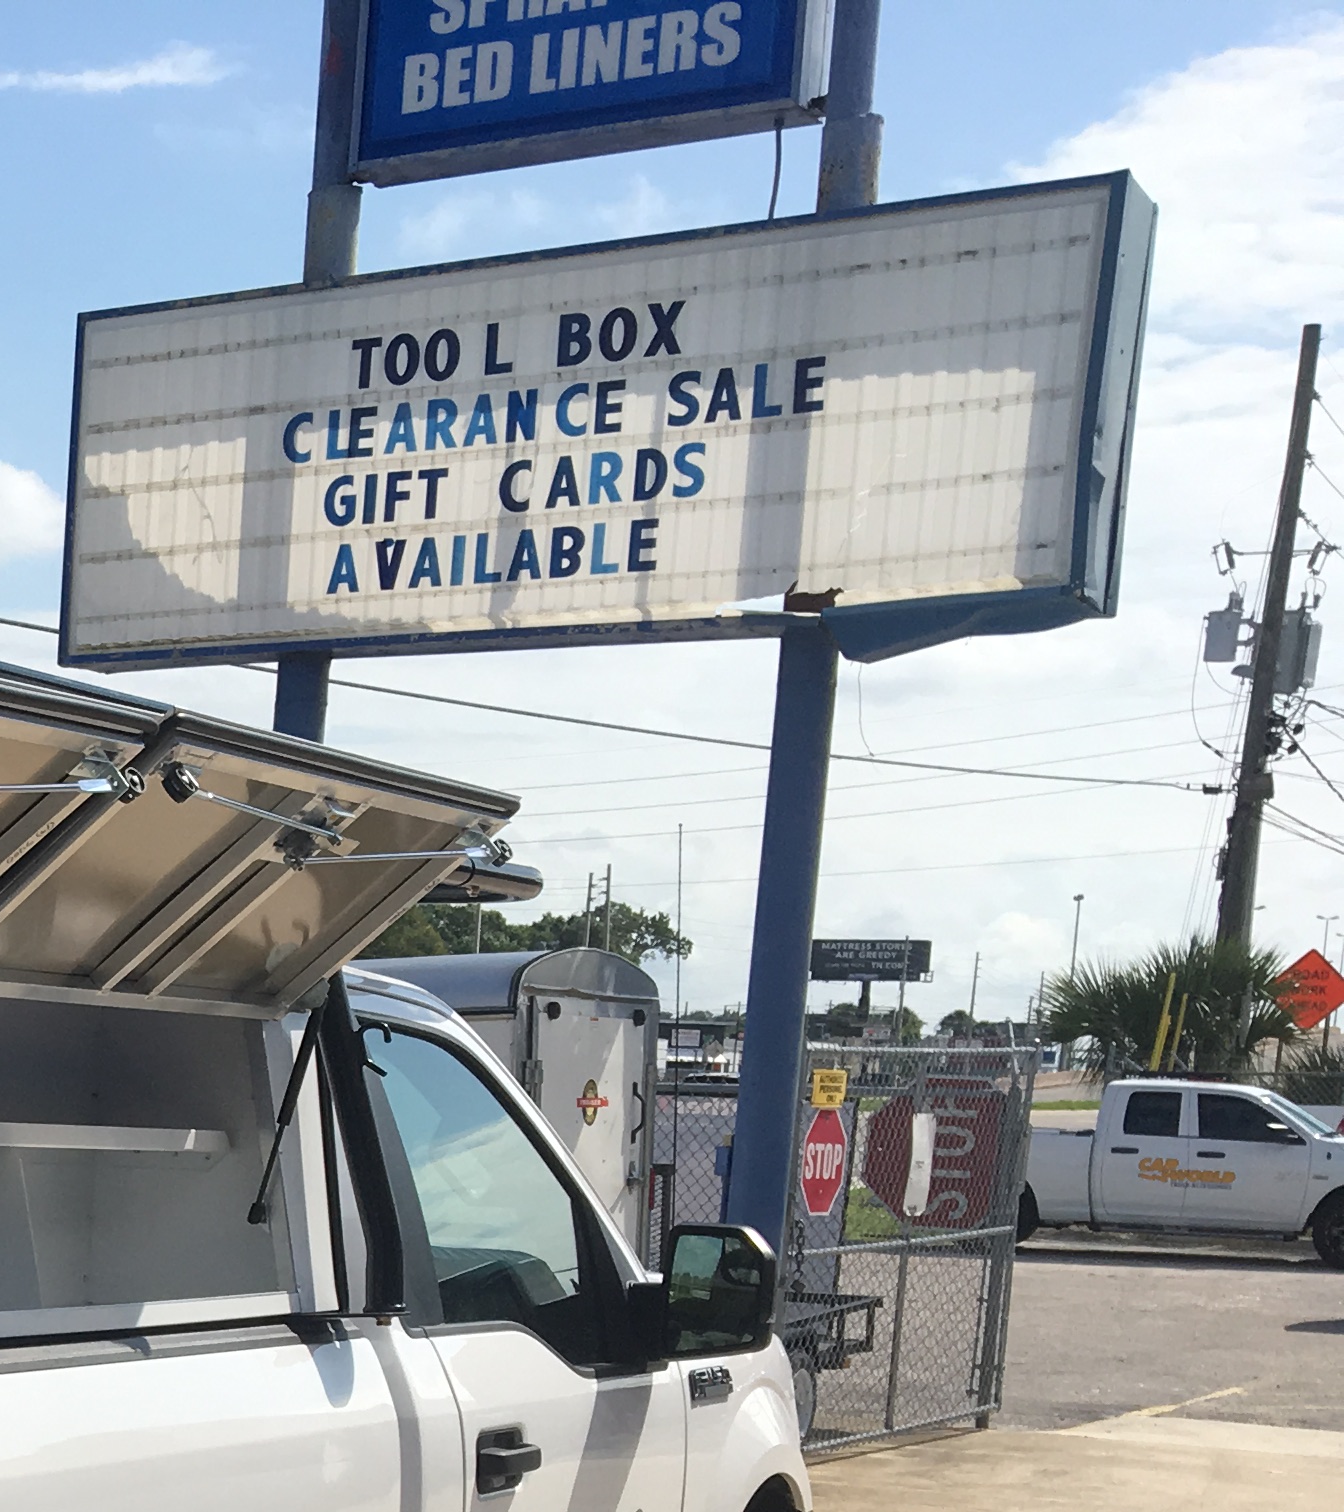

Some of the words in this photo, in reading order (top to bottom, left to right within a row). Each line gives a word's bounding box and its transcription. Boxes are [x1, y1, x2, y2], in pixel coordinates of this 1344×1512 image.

[401, 40, 514, 115] BED
[528, 1, 743, 95] LINERS
[556, 300, 687, 368] BOX
[282, 379, 627, 464] CLEARANCE
[667, 355, 826, 428] SALE
[323, 467, 449, 527] GIFT
[498, 442, 707, 513] CARDS
[325, 518, 660, 595] AVAILABLE
[821, 942, 872, 951] MATTRESS
[834, 951, 855, 959] ARE
[858, 951, 898, 959] GREEDY
[805, 1142, 843, 1180] STOP
